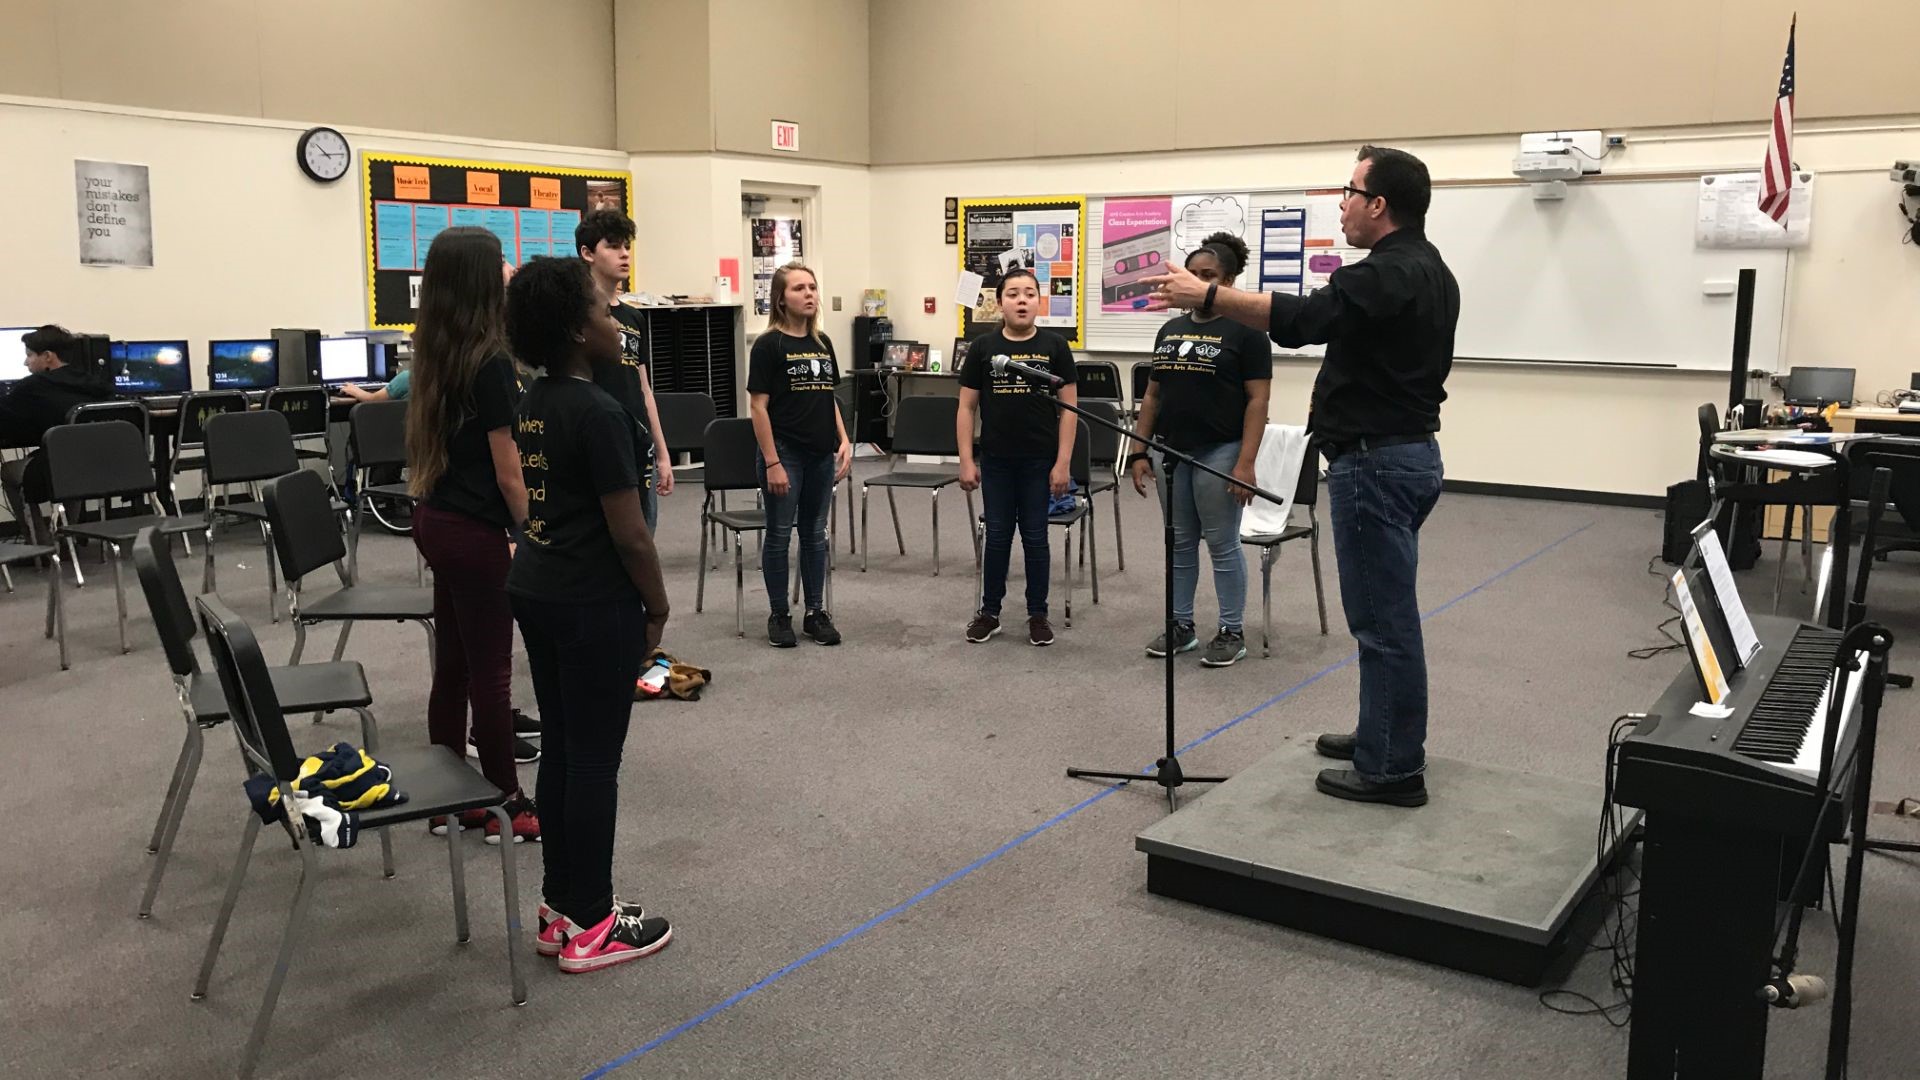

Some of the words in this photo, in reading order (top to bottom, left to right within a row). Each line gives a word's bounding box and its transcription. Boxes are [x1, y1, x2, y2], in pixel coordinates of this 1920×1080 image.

[777, 125, 794, 147] EXIT
[84, 177, 112, 189] your
[473, 184, 494, 193] Vocal
[85, 190, 140, 202] mistakes
[533, 189, 559, 198] Theatre
[86, 200, 117, 213] don't
[86, 213, 126, 226] define
[1108, 218, 1126, 226] Class
[1126, 217, 1168, 228] Expectations
[87, 227, 112, 239] you
